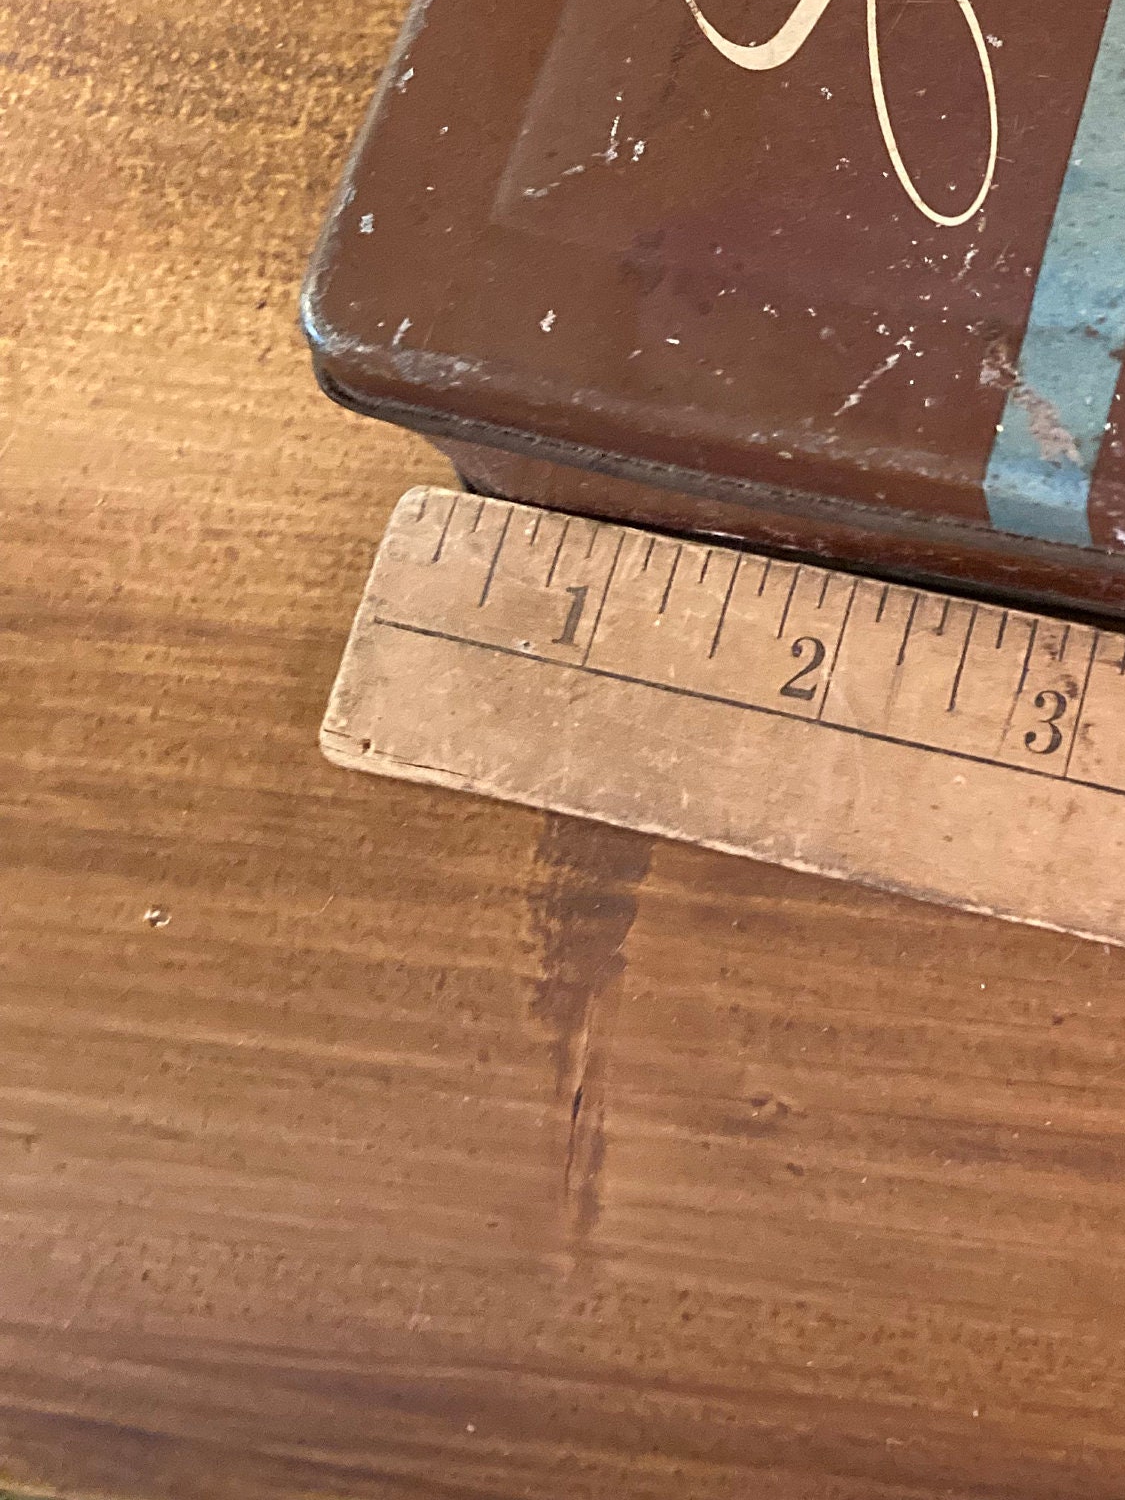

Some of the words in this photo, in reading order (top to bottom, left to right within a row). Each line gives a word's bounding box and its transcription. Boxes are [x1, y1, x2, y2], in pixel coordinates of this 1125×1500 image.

[551, 586, 588, 646] 1
[779, 635, 827, 702] 2
[1024, 689, 1068, 756] 3
